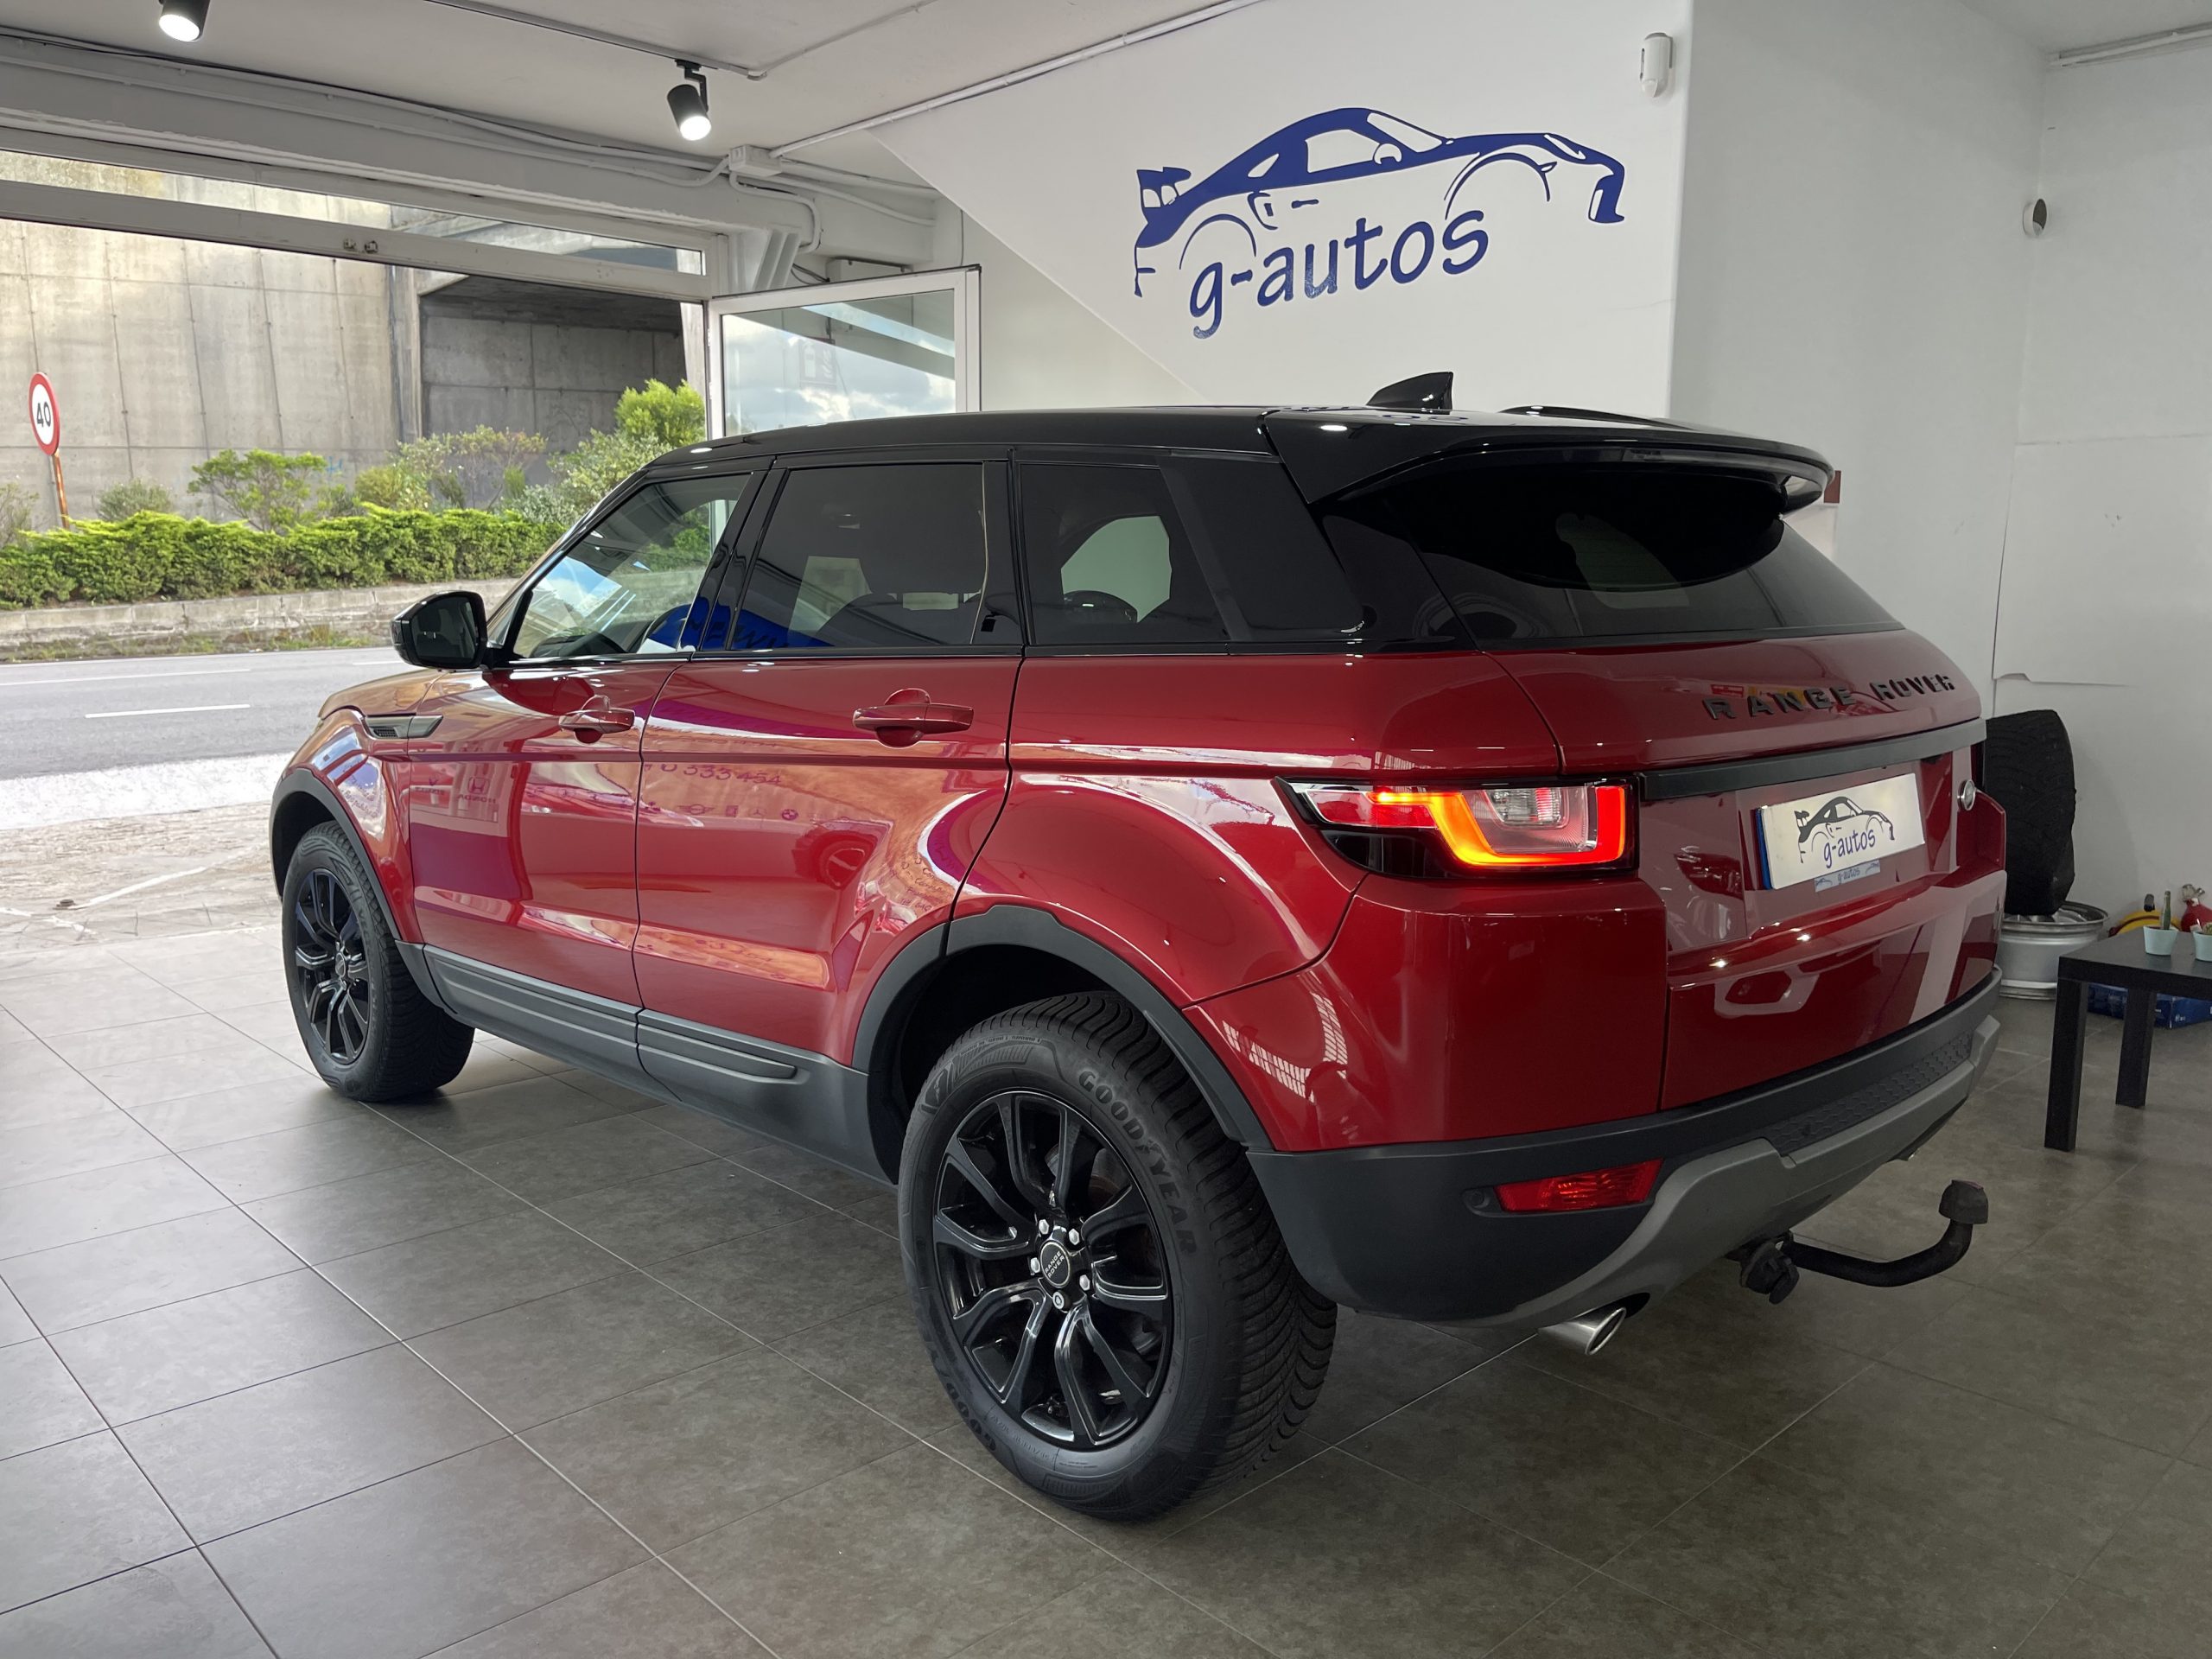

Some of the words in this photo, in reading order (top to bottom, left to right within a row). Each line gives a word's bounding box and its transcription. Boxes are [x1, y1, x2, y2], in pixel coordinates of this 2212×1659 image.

[1189, 210, 1489, 340] g-autos
[36, 401, 52, 428] 40
[1702, 685, 1858, 721] RANGE
[1869, 674, 1955, 701] ROVER
[1823, 828, 1876, 868] g-autos
[1079, 1071, 1198, 1255] GOODYEAR
[1045, 1250, 1062, 1274] RANGE
[1048, 1255, 1065, 1279] ROVER
